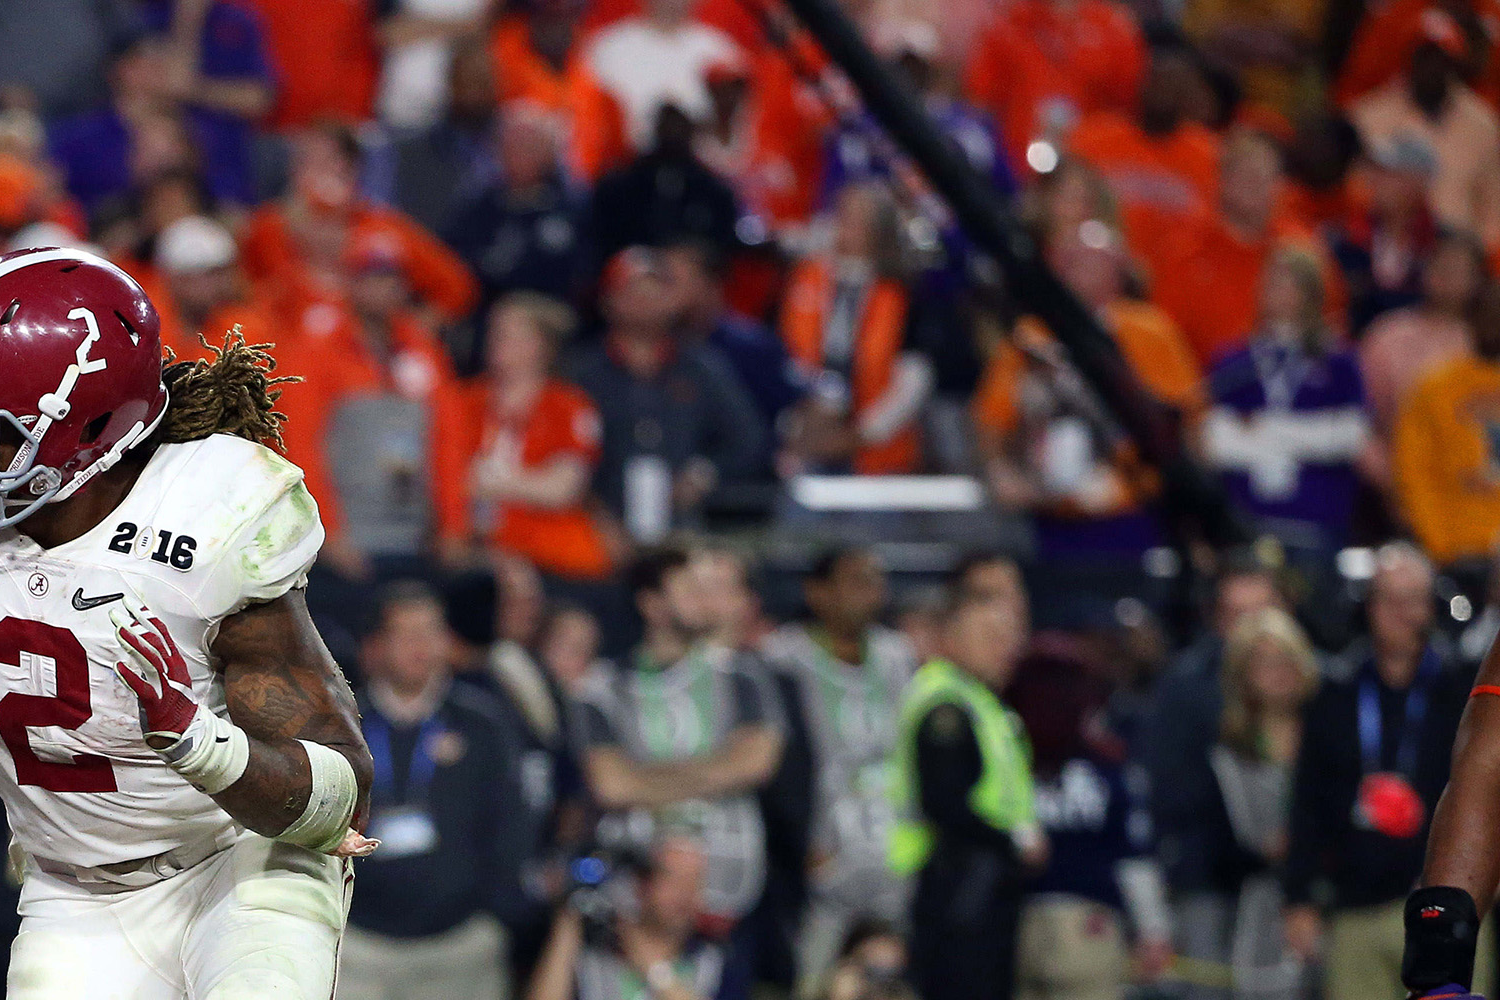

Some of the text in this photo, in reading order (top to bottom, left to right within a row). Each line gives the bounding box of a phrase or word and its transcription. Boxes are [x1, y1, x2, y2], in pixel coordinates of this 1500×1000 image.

[67, 307, 107, 374] 2
[9, 443, 32, 472] RIMSON
[74, 468, 94, 487] TIDE
